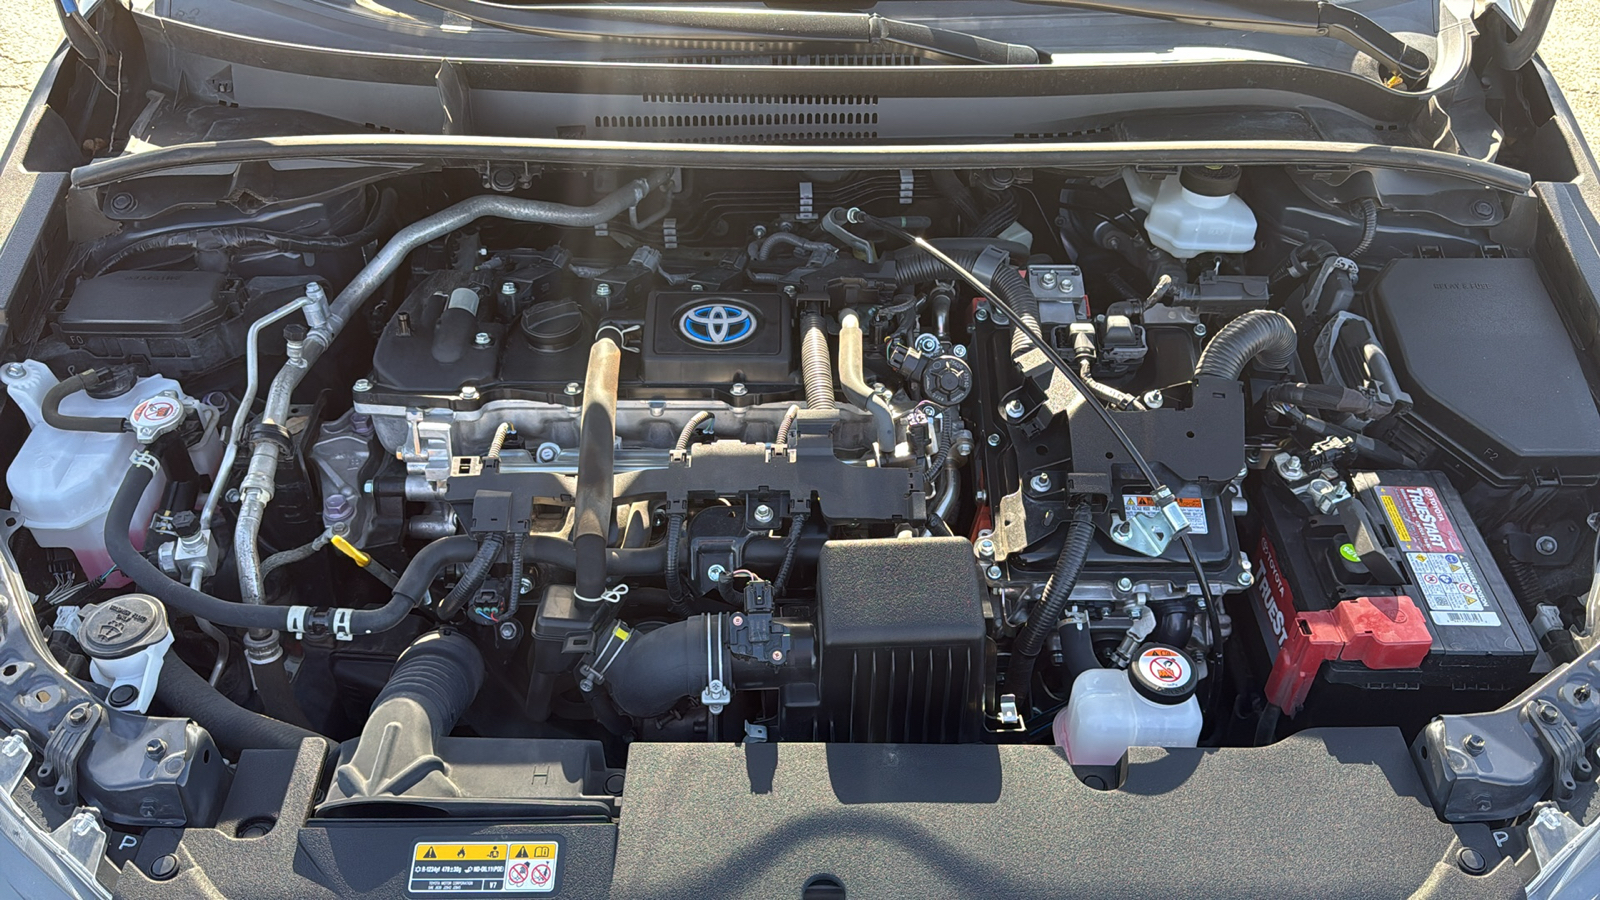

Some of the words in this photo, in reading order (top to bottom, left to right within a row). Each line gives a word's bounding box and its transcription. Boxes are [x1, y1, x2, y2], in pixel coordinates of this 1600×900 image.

[1428, 497, 1445, 522] TOYOTA
[1267, 553, 1285, 598] TOYOTA
[1255, 558, 1289, 649] TRUEST
[118, 835, 138, 850] P
[1492, 831, 1509, 848] P
